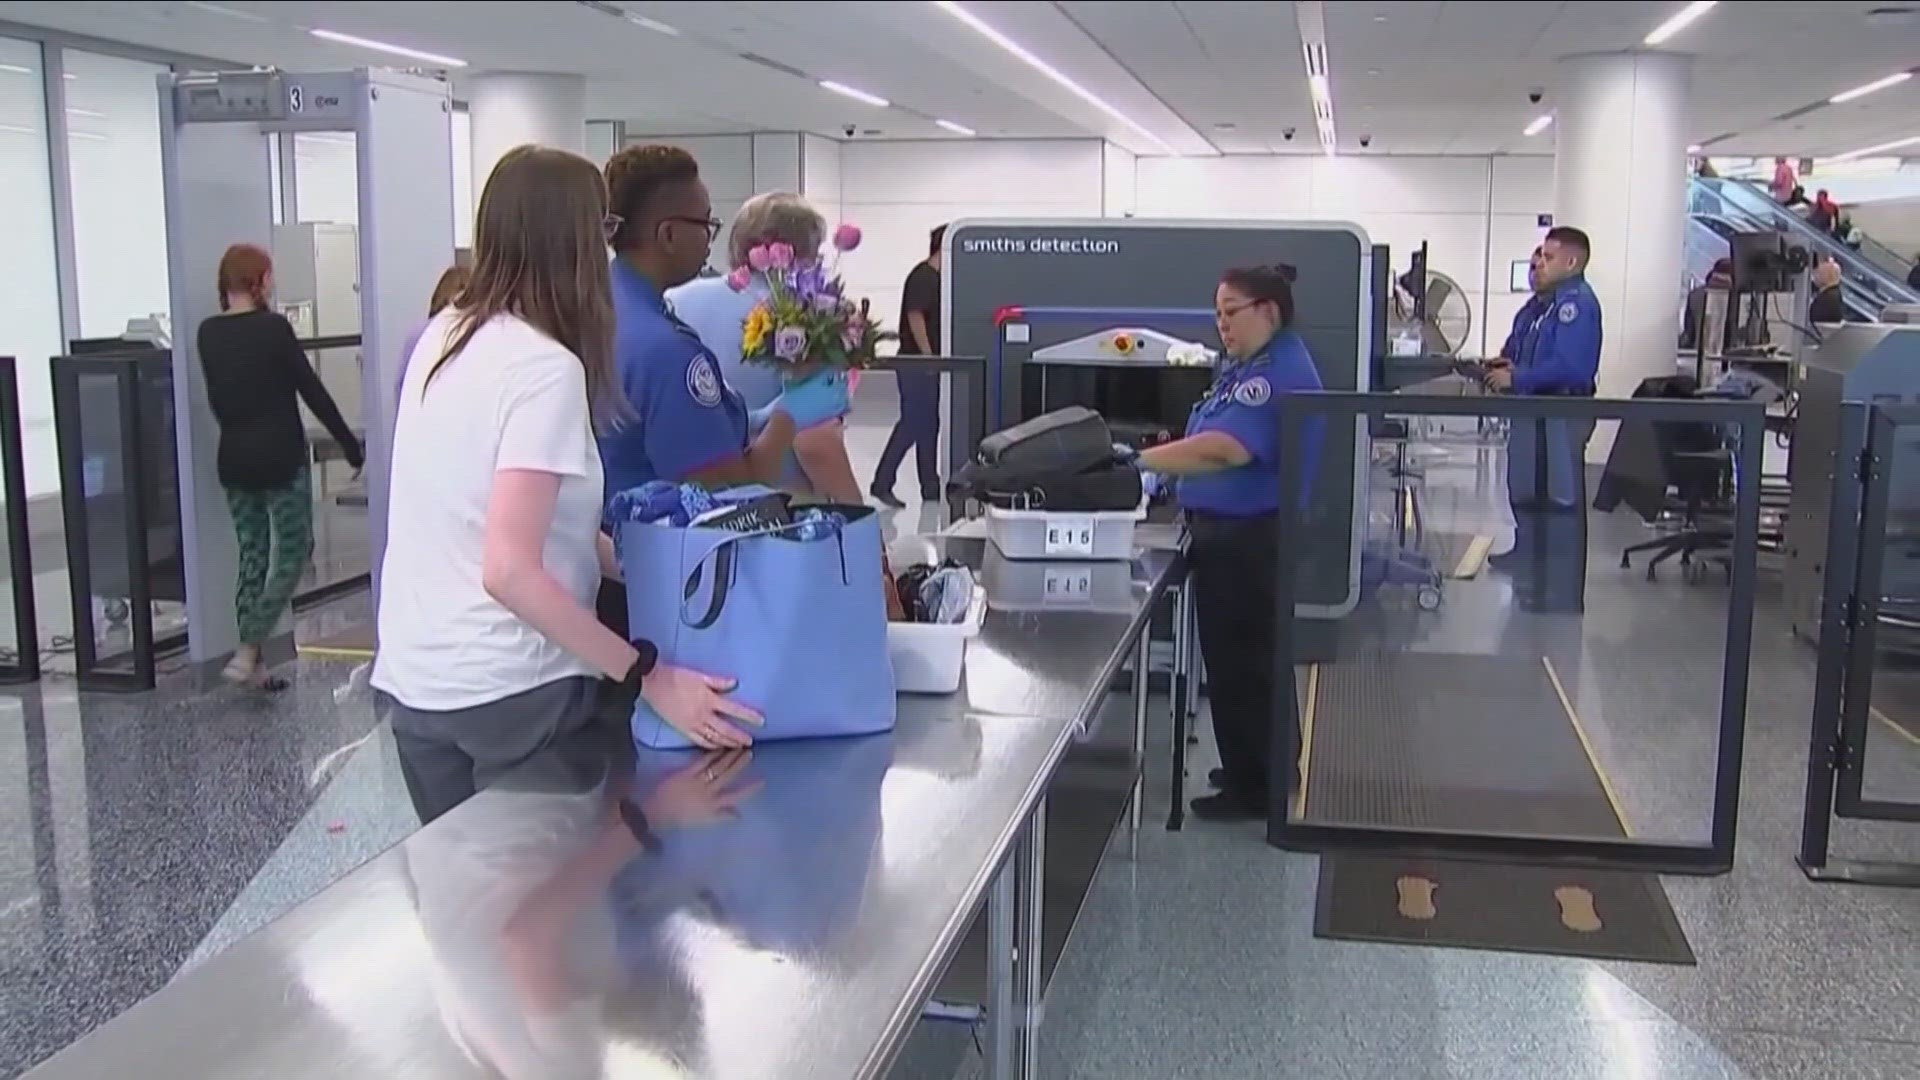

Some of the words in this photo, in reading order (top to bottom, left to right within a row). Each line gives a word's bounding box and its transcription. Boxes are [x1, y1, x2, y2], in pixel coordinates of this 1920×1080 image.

[291, 88, 301, 112] 3
[963, 238, 1025, 252] smiths
[1030, 238, 1119, 252] detection
